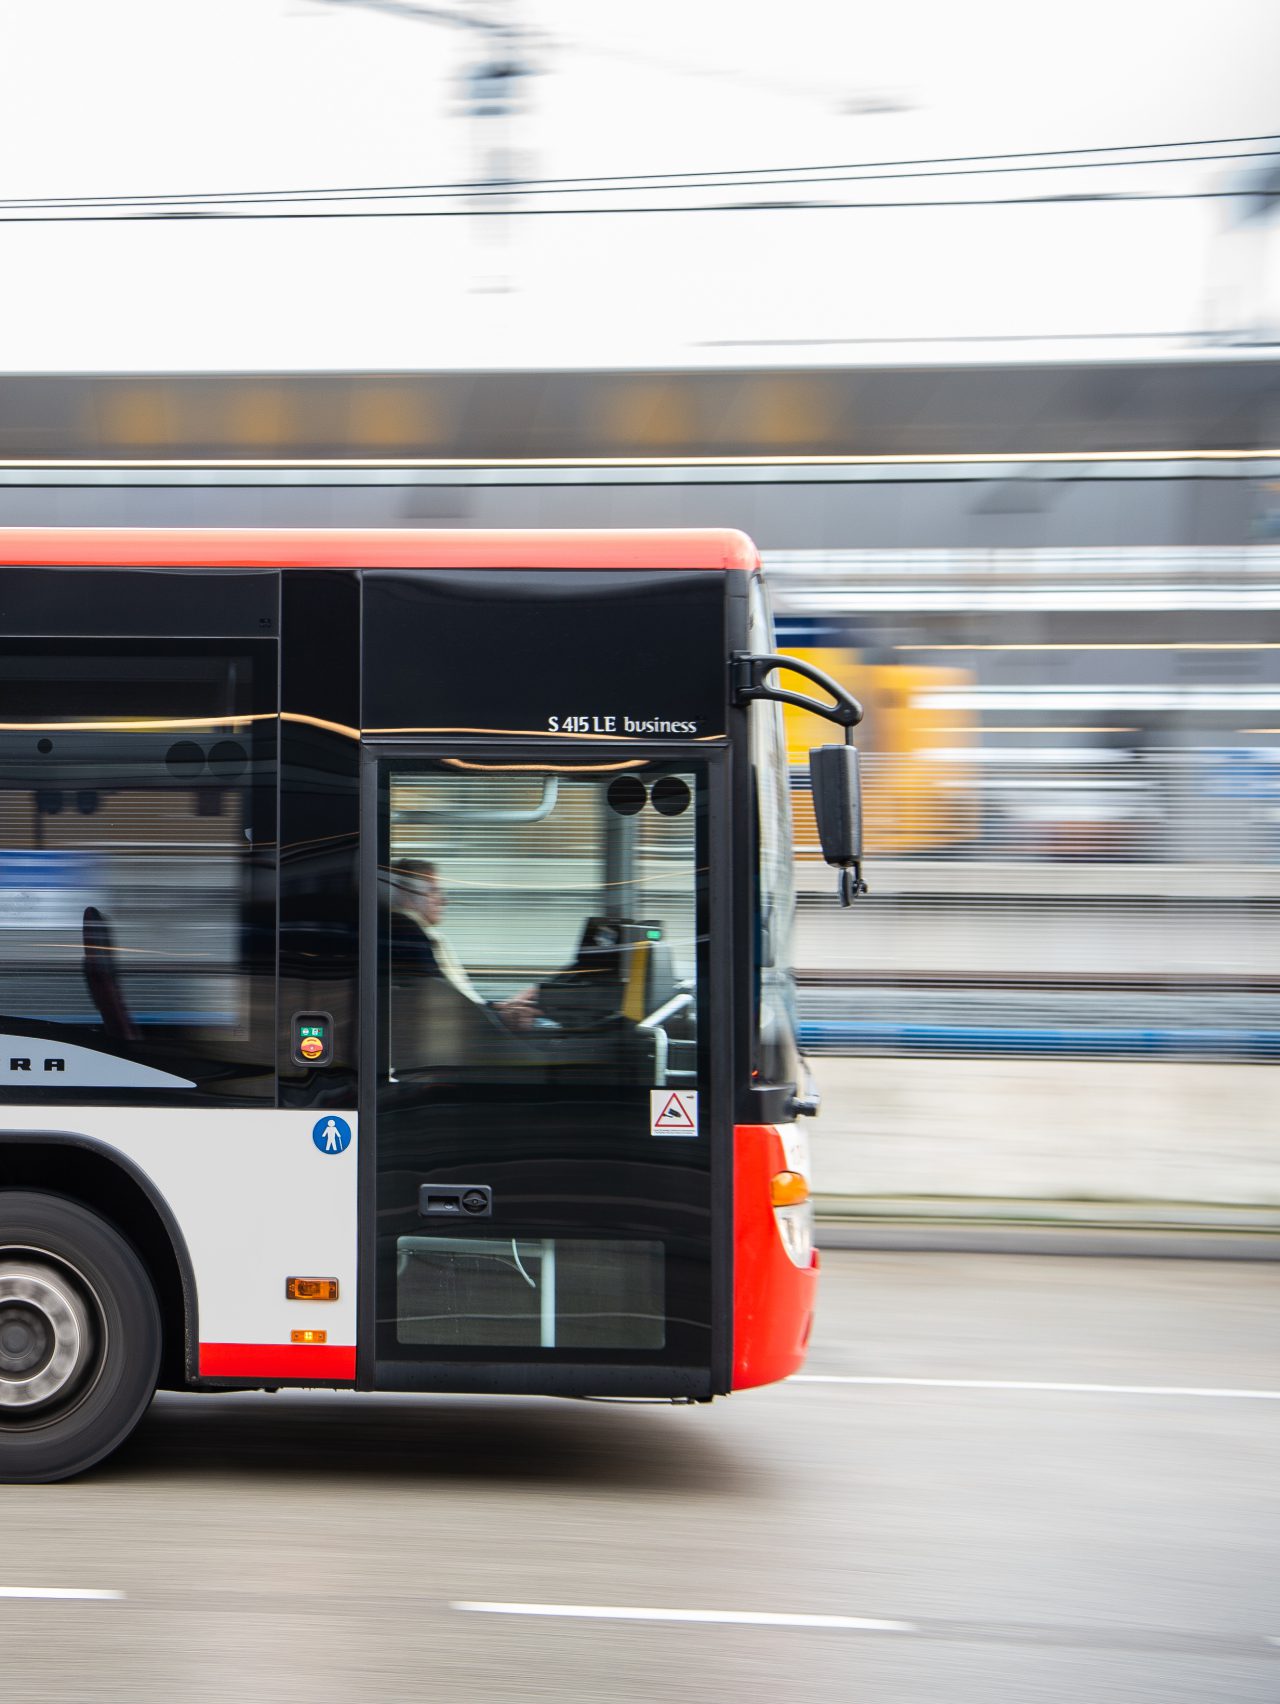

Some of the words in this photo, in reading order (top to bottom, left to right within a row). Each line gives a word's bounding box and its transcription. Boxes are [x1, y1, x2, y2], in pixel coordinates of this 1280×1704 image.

[548, 716, 559, 732] S
[562, 716, 589, 733] 415
[592, 716, 616, 732] LE
[624, 716, 697, 733] business
